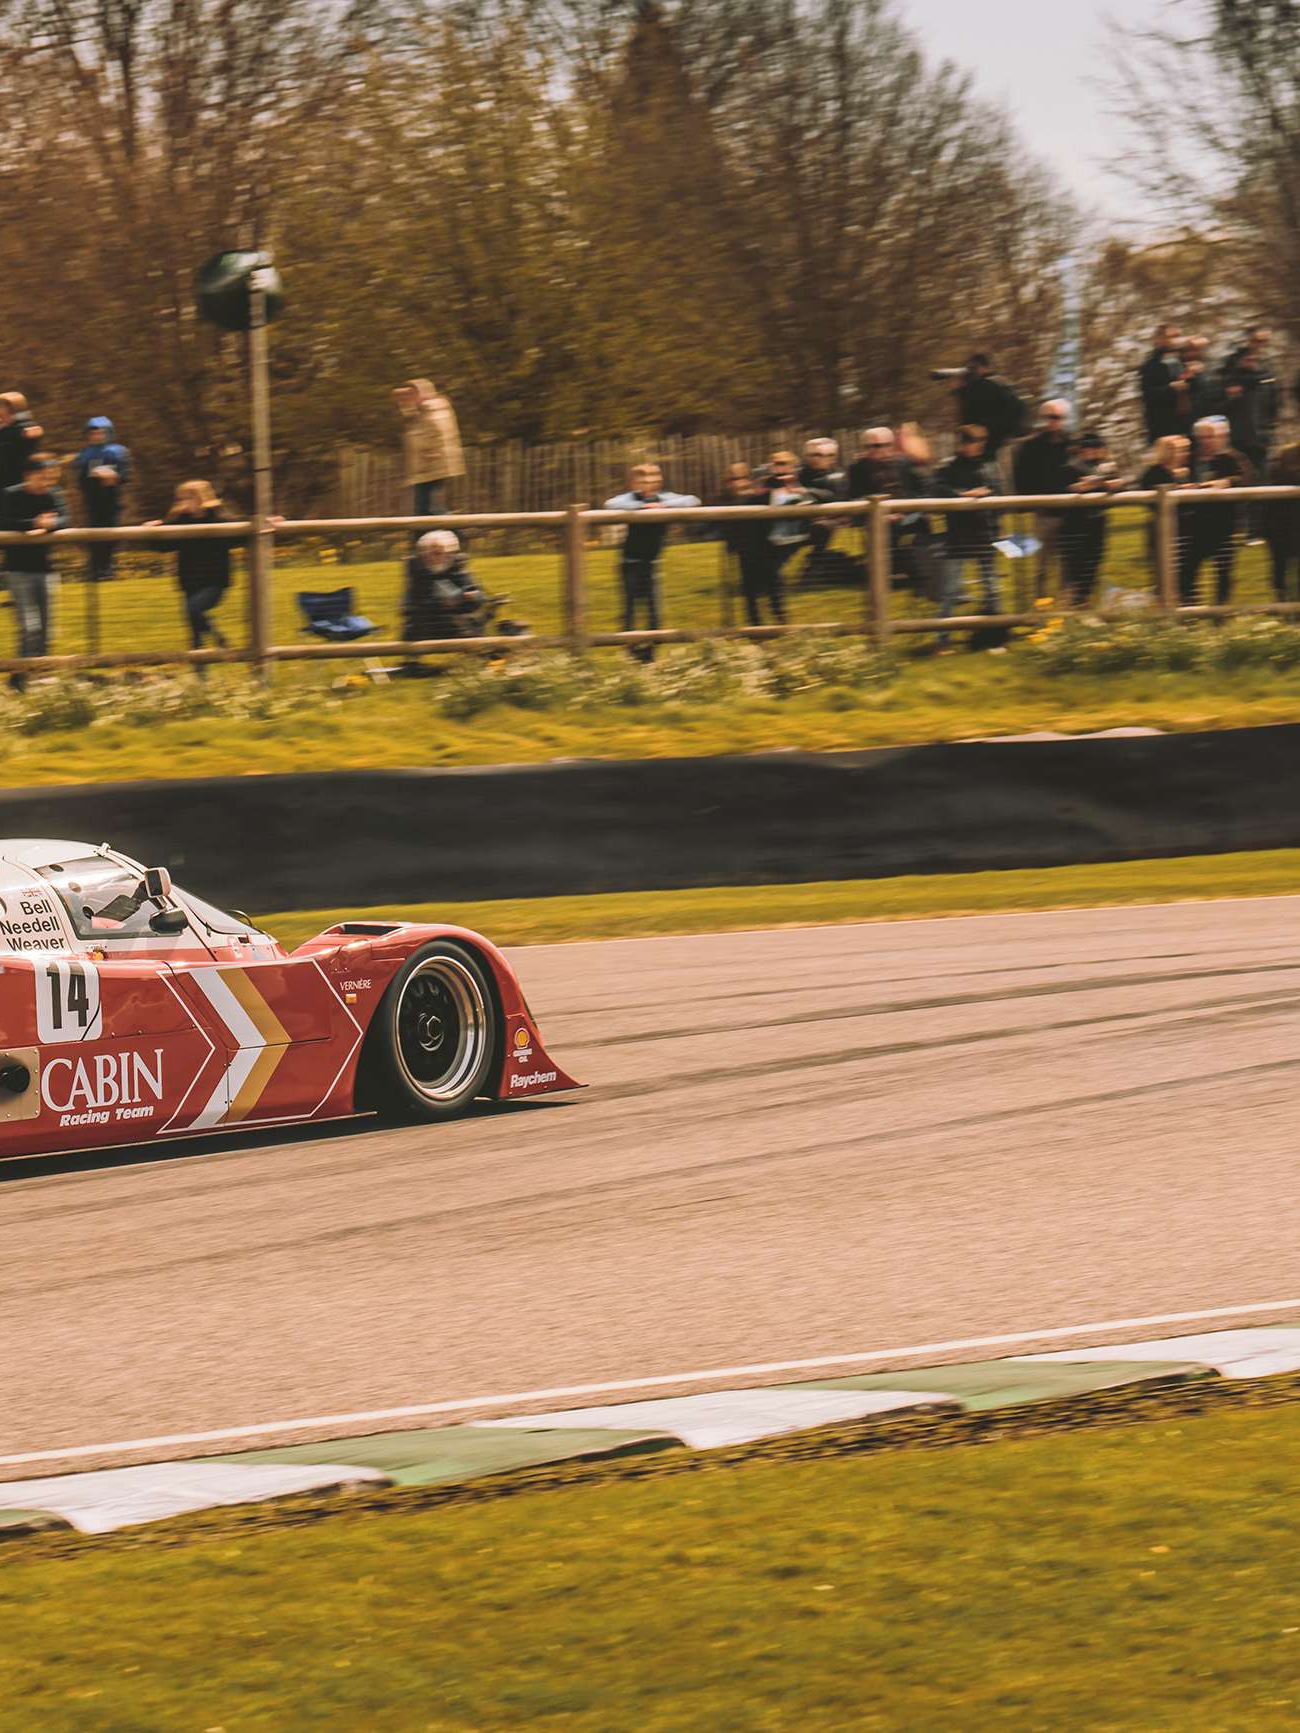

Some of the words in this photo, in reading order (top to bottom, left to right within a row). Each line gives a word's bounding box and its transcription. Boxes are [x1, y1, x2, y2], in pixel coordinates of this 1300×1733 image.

[20, 899, 52, 915] Bell
[6, 937, 64, 952] Weaver
[46, 961, 89, 1029] 14
[41, 1049, 164, 1112] CABIN
[510, 1071, 557, 1088] Raychem
[59, 1109, 110, 1127] Racing
[115, 1106, 154, 1120] Team
